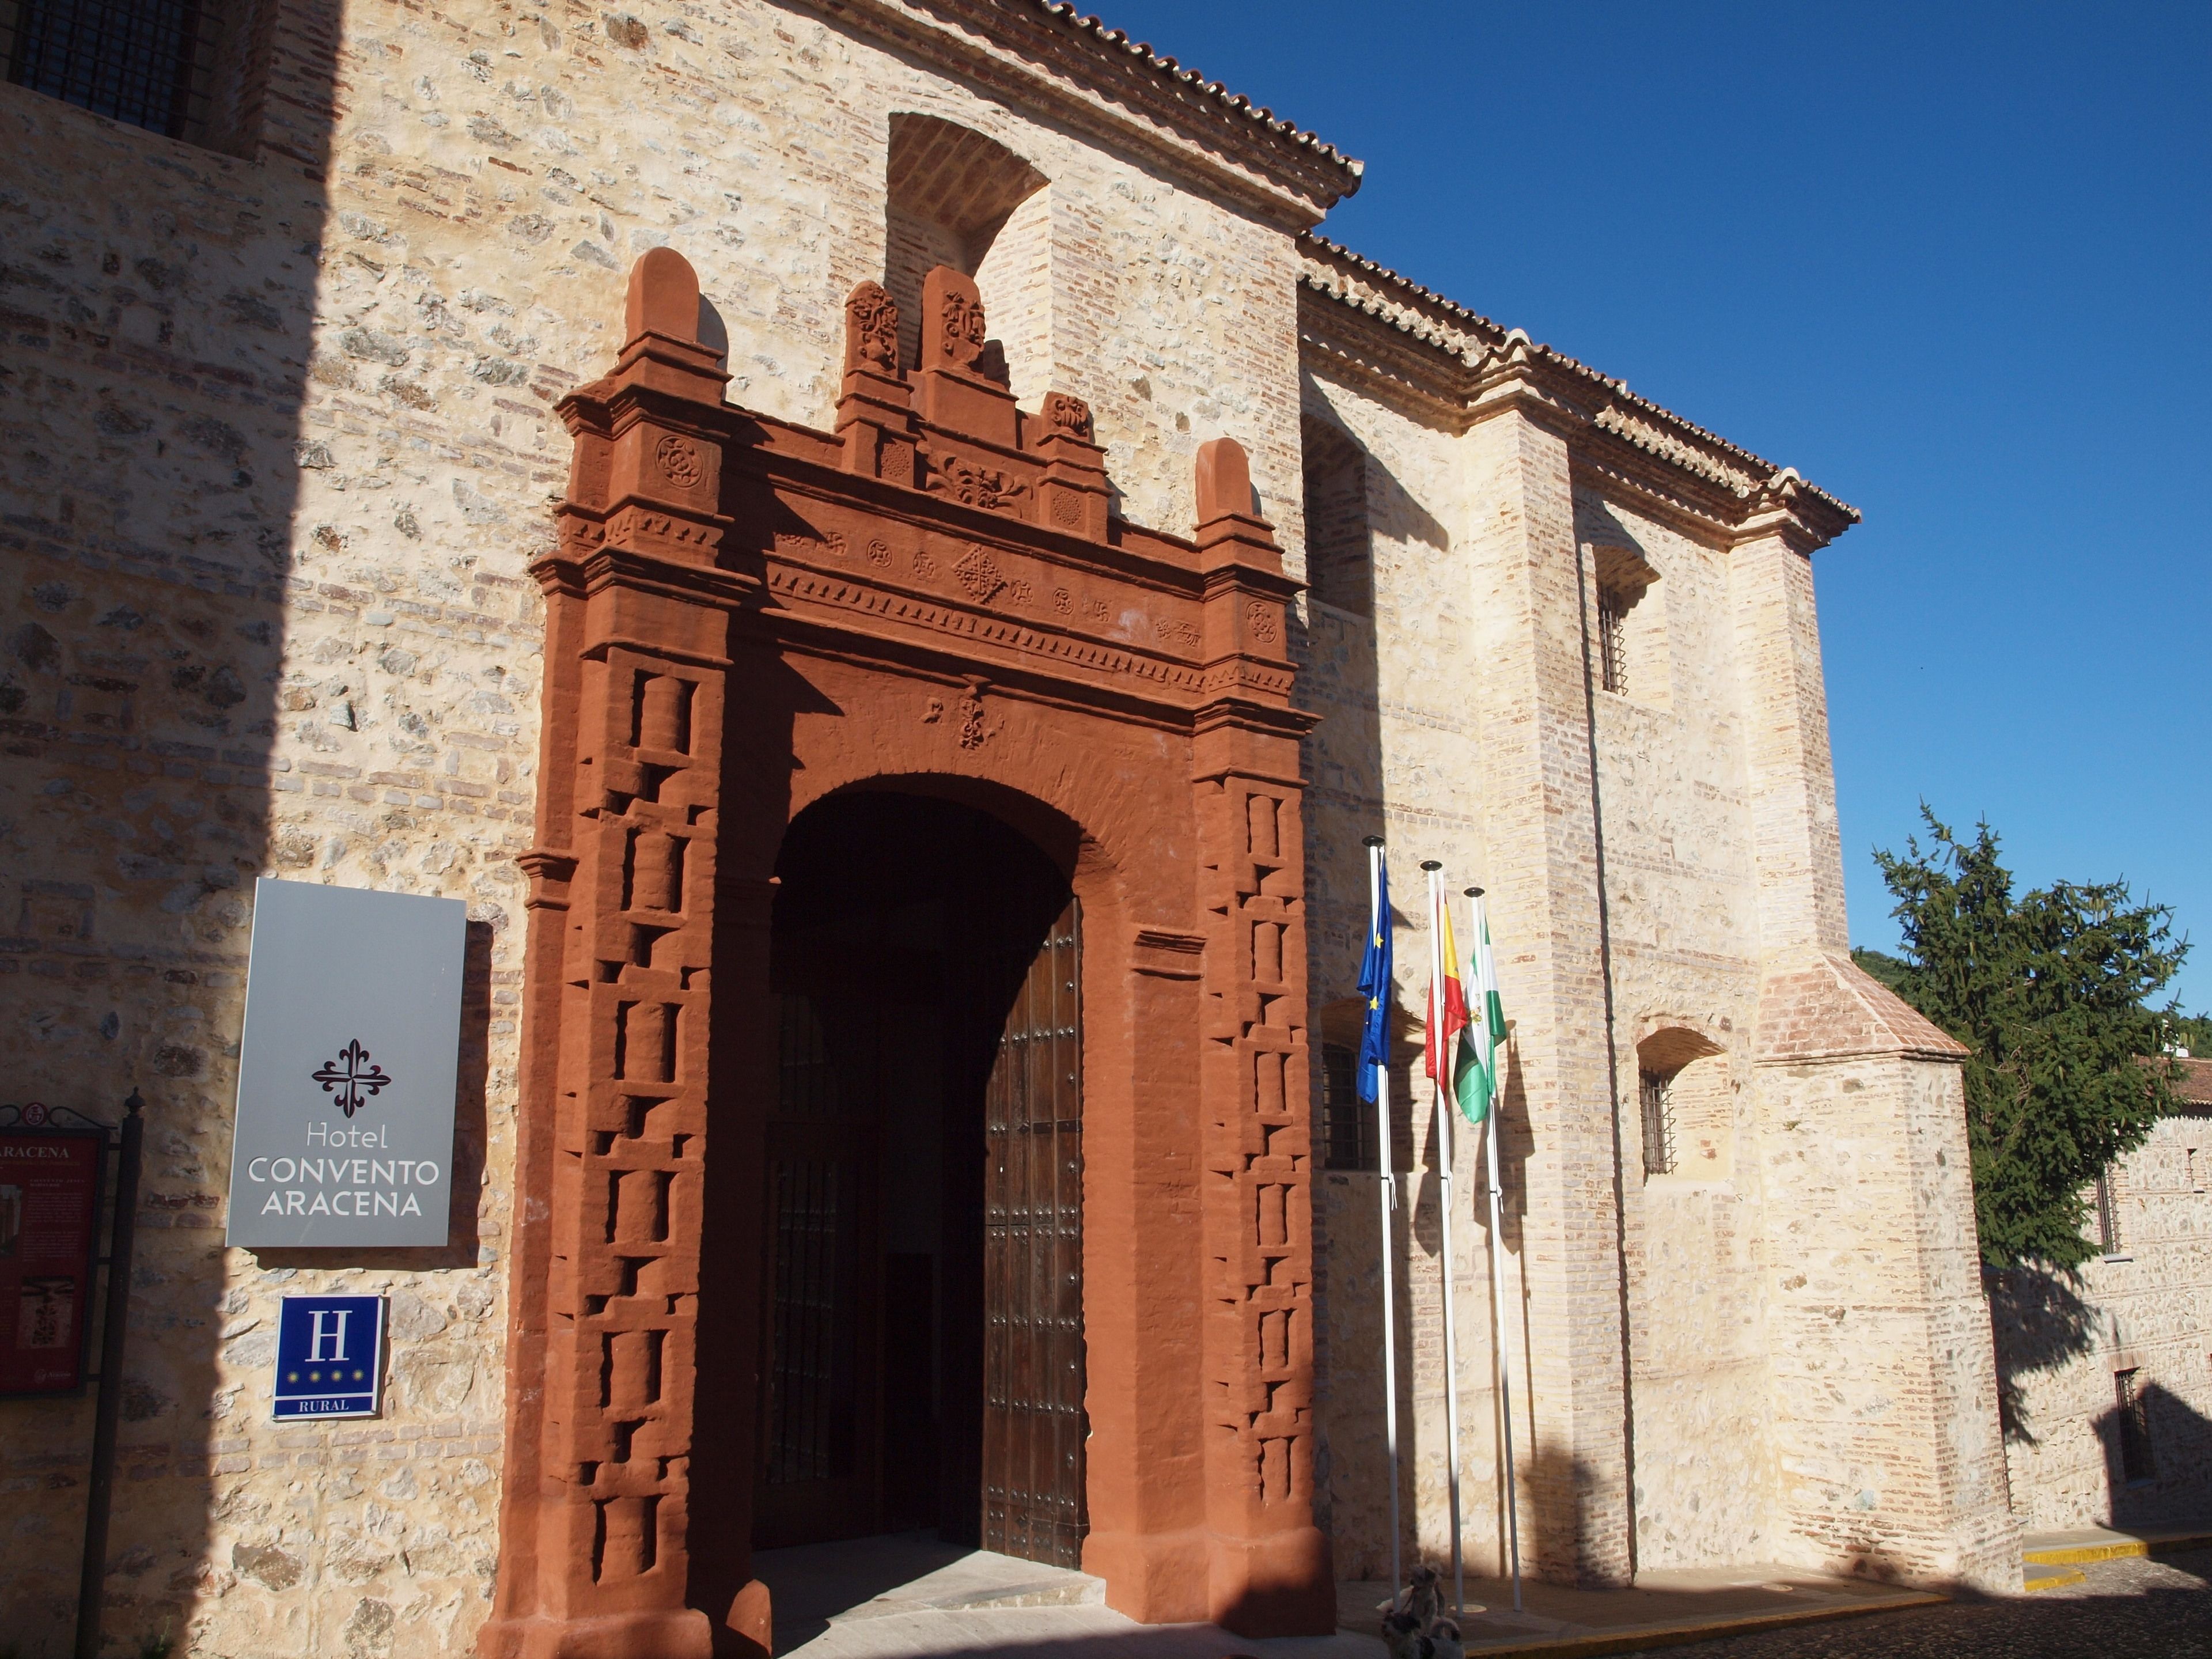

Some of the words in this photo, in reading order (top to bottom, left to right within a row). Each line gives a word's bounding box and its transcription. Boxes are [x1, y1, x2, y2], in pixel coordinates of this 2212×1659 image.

[306, 1122, 388, 1149] Hotel
[248, 1156, 439, 1185] CONVENTO
[261, 1190, 422, 1217] ARACENA
[305, 1310, 353, 1362] H
[299, 1399, 349, 1412] RURAL
